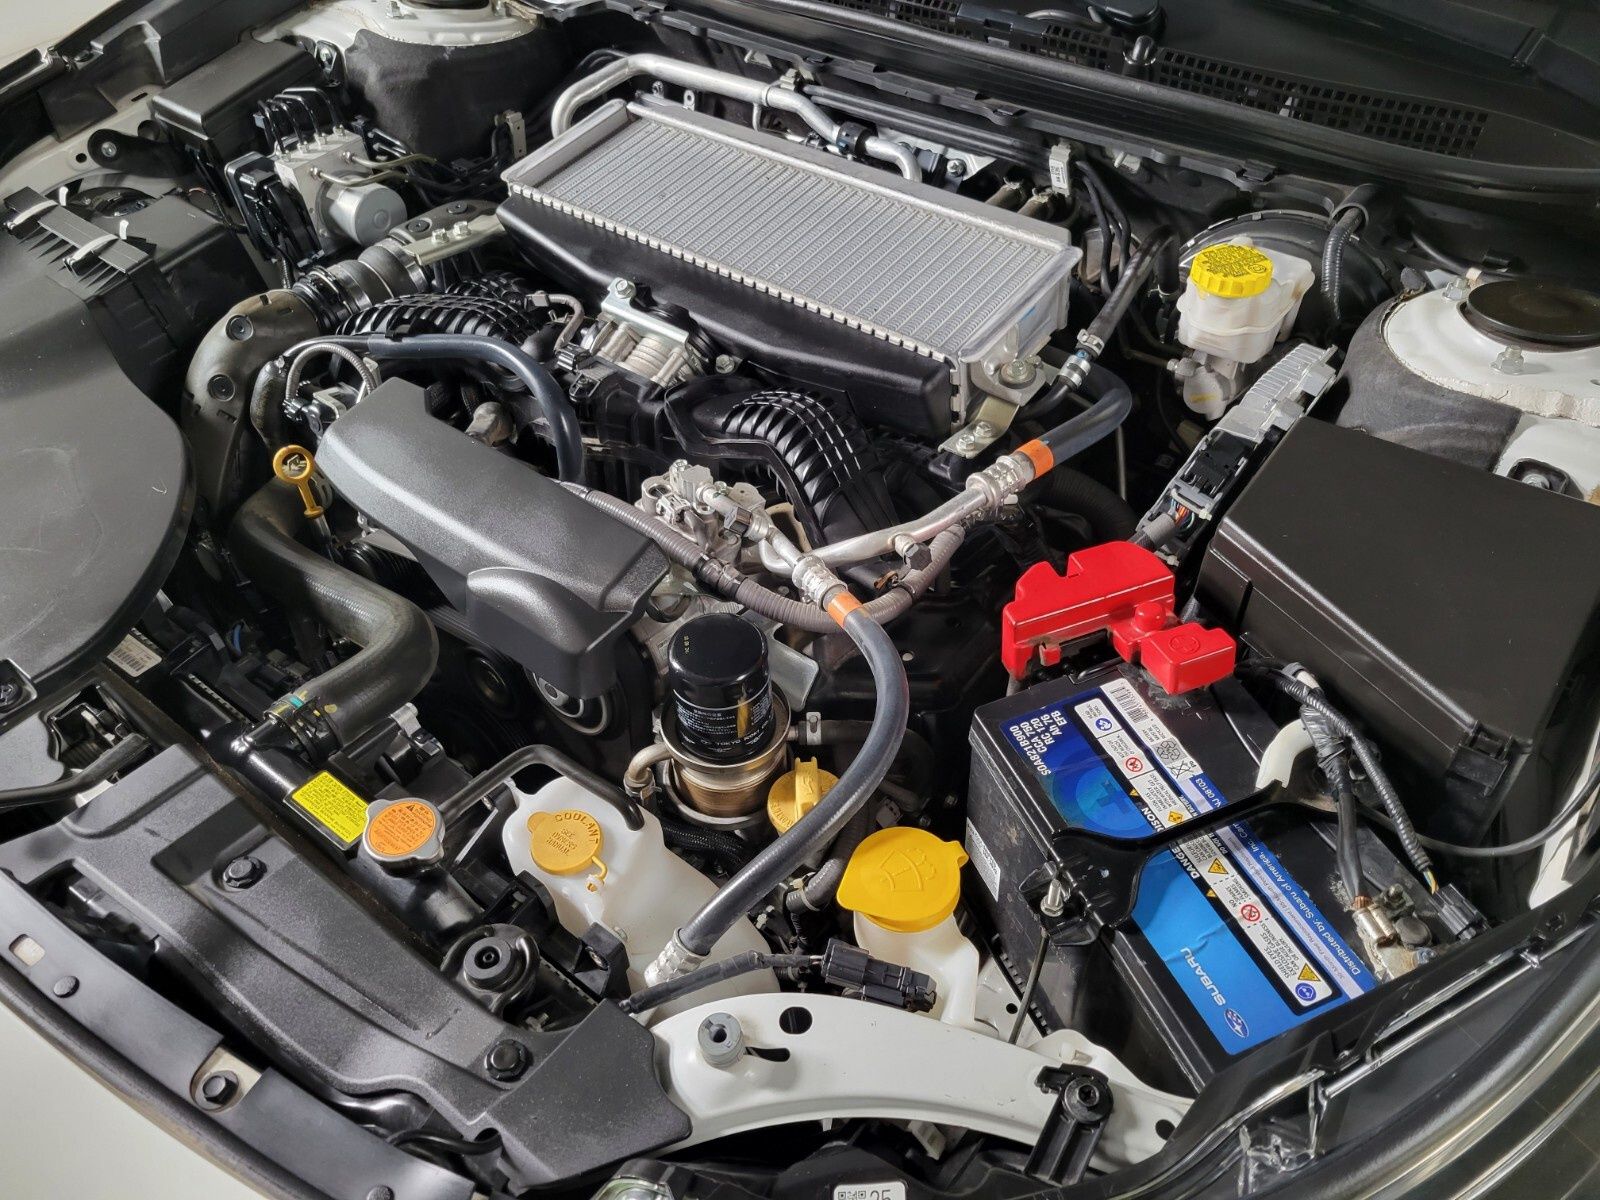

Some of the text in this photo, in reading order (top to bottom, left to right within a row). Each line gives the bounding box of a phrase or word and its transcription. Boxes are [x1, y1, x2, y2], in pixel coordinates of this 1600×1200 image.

[1028, 716, 1055, 745] RC 120
[1038, 713, 1063, 737] Ah 76
[1049, 709, 1068, 726] EFB
[1018, 720, 1048, 754] CCA 750
[1194, 777, 1216, 799] 08103
[554, 812, 599, 844] COOLANT
[1169, 845, 1201, 880] DANGE
[1254, 850, 1286, 884] America,
[1279, 881, 1293, 892] of
[1227, 898, 1238, 908] NO
[1287, 890, 1315, 919] Subaru
[1310, 917, 1327, 932] by:
[1258, 931, 1297, 976] EXPLOSIVE GASES
[1259, 921, 1300, 971] CAN CAUSE BLINDNESS
[1320, 930, 1362, 975] Distributed
[1178, 945, 1228, 1007] SUBARU
[1272, 958, 1292, 979] SHIELD
